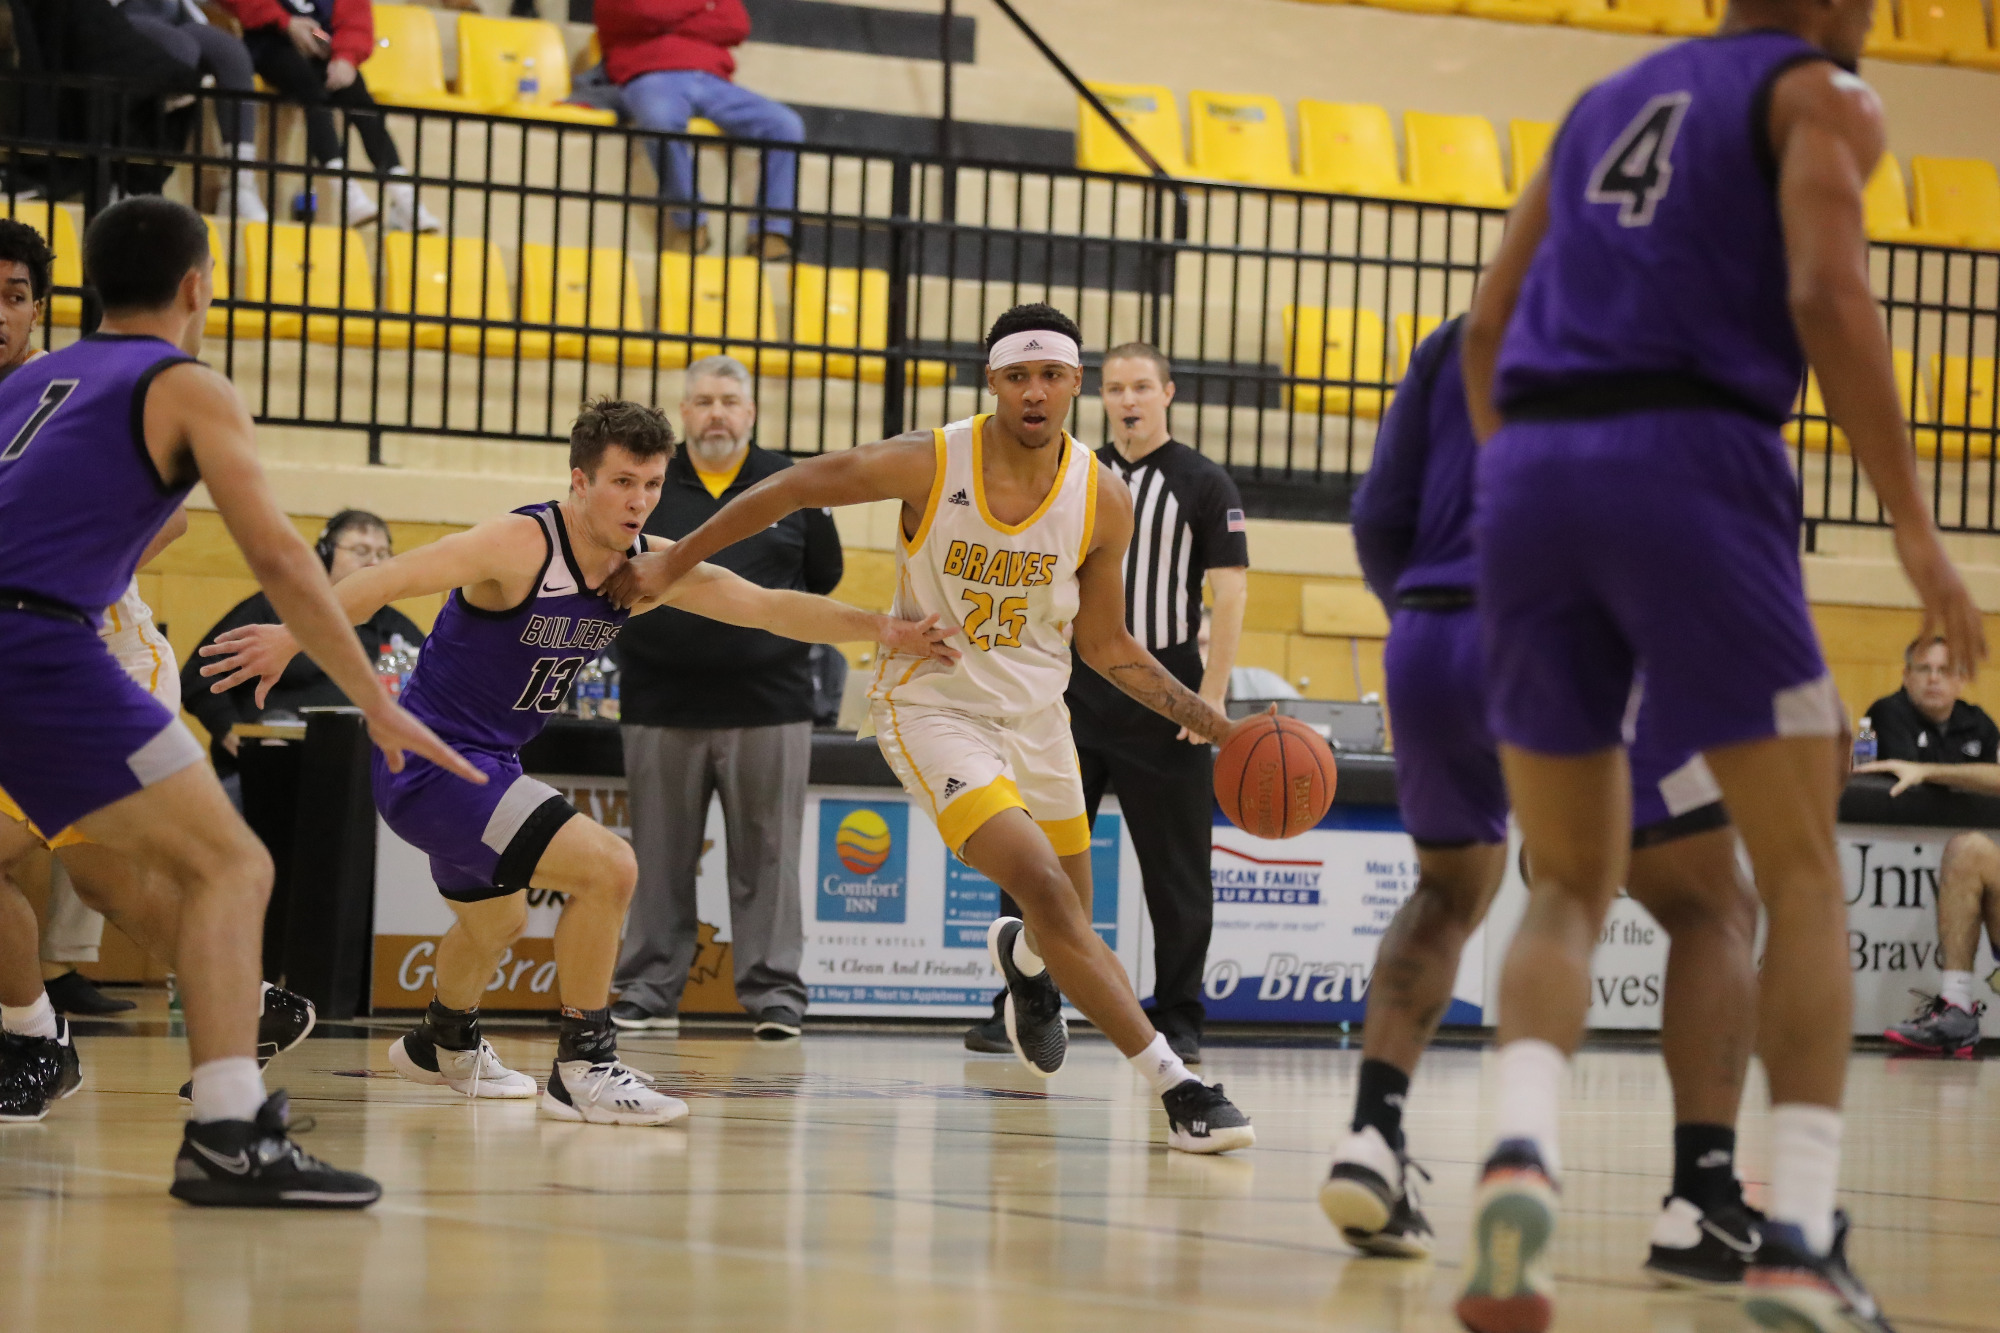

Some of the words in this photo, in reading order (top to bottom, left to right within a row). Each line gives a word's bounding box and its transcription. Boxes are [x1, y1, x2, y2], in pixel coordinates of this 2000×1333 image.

[1585, 89, 1692, 228] 4
[0, 379, 80, 461] 1
[943, 540, 1058, 587] BRAVES
[520, 614, 622, 651] BUILDERS
[961, 588, 1028, 652] 25
[512, 657, 584, 713] 13
[823, 874, 899, 898] Comfort
[1264, 871, 1320, 887] FAMILY
[846, 898, 877, 913] INN
[818, 935, 867, 946] CHOICE
[876, 936, 926, 948] HOTELS
[1623, 920, 1654, 945] the
[398, 941, 438, 991] G
[841, 958, 884, 974] Clean
[892, 959, 919, 975] And
[924, 960, 985, 980] Friendly
[1592, 974, 1660, 1008] ves
